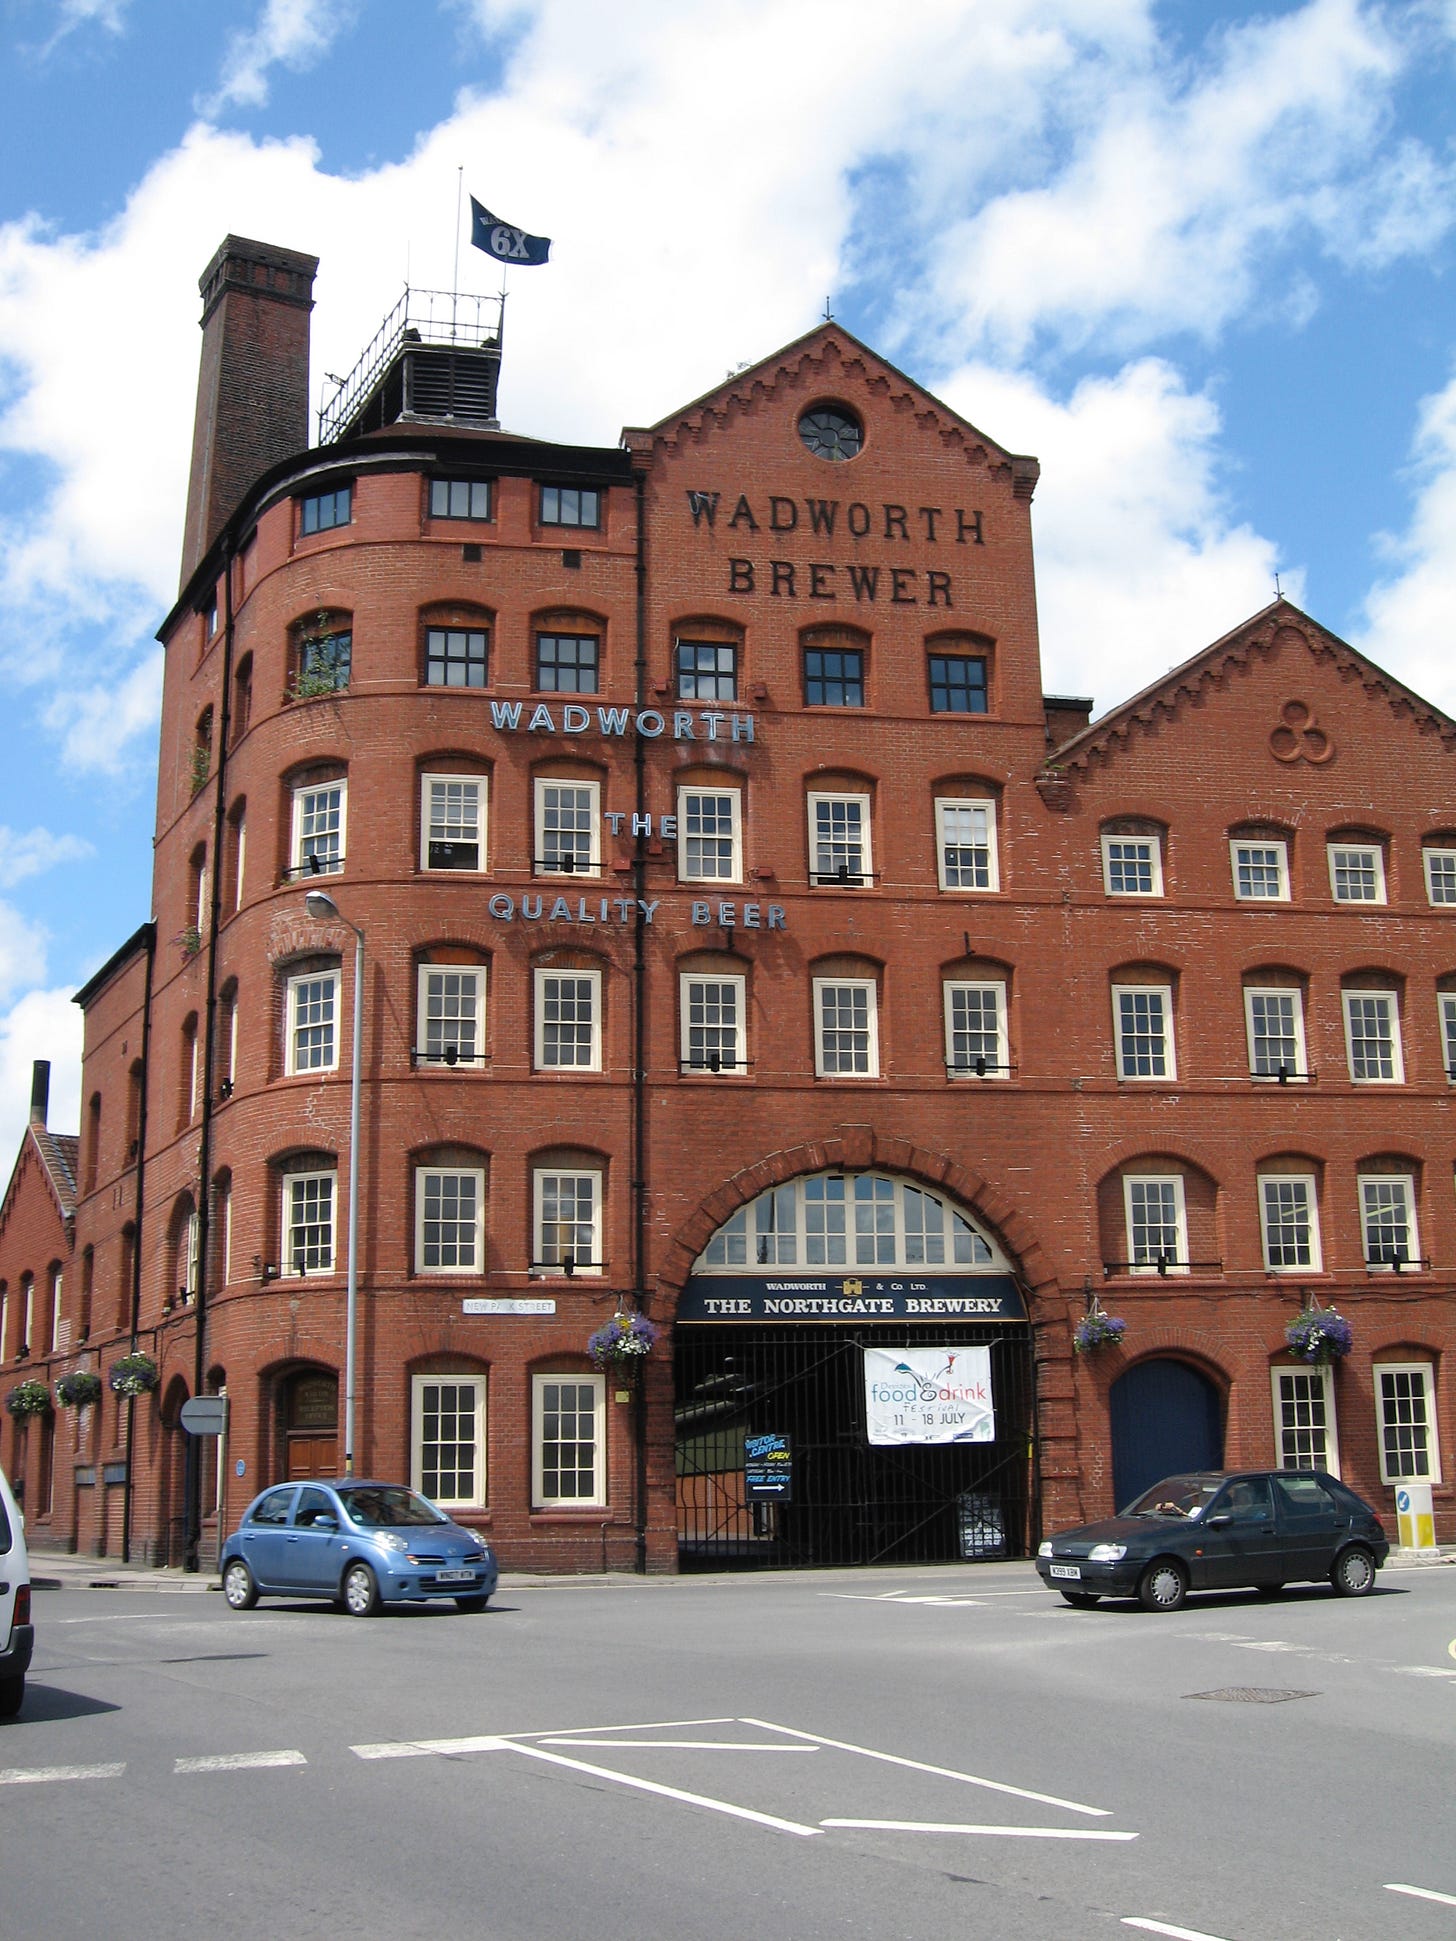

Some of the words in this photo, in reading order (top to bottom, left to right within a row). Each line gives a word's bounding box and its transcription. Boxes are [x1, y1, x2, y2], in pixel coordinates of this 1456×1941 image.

[491, 226, 530, 258] 6X
[686, 490, 985, 545] WADWORTH
[728, 558, 953, 606] BREWER
[490, 701, 755, 742] WADWORTH
[604, 812, 677, 840] THE
[488, 893, 659, 924] QUALITY
[692, 901, 788, 930] BEER
[491, 1303, 515, 1311] PAK
[704, 1299, 752, 1314] THE
[764, 1298, 894, 1314] NORTHGATE
[905, 1298, 1002, 1314] BREWERY
[872, 1382, 917, 1402] food
[939, 1382, 987, 1400] drink
[894, 1414, 904, 1425] 11
[922, 1414, 934, 1425] 18
[939, 1413, 966, 1424] JULY
[767, 1452, 790, 1460] OPEN
